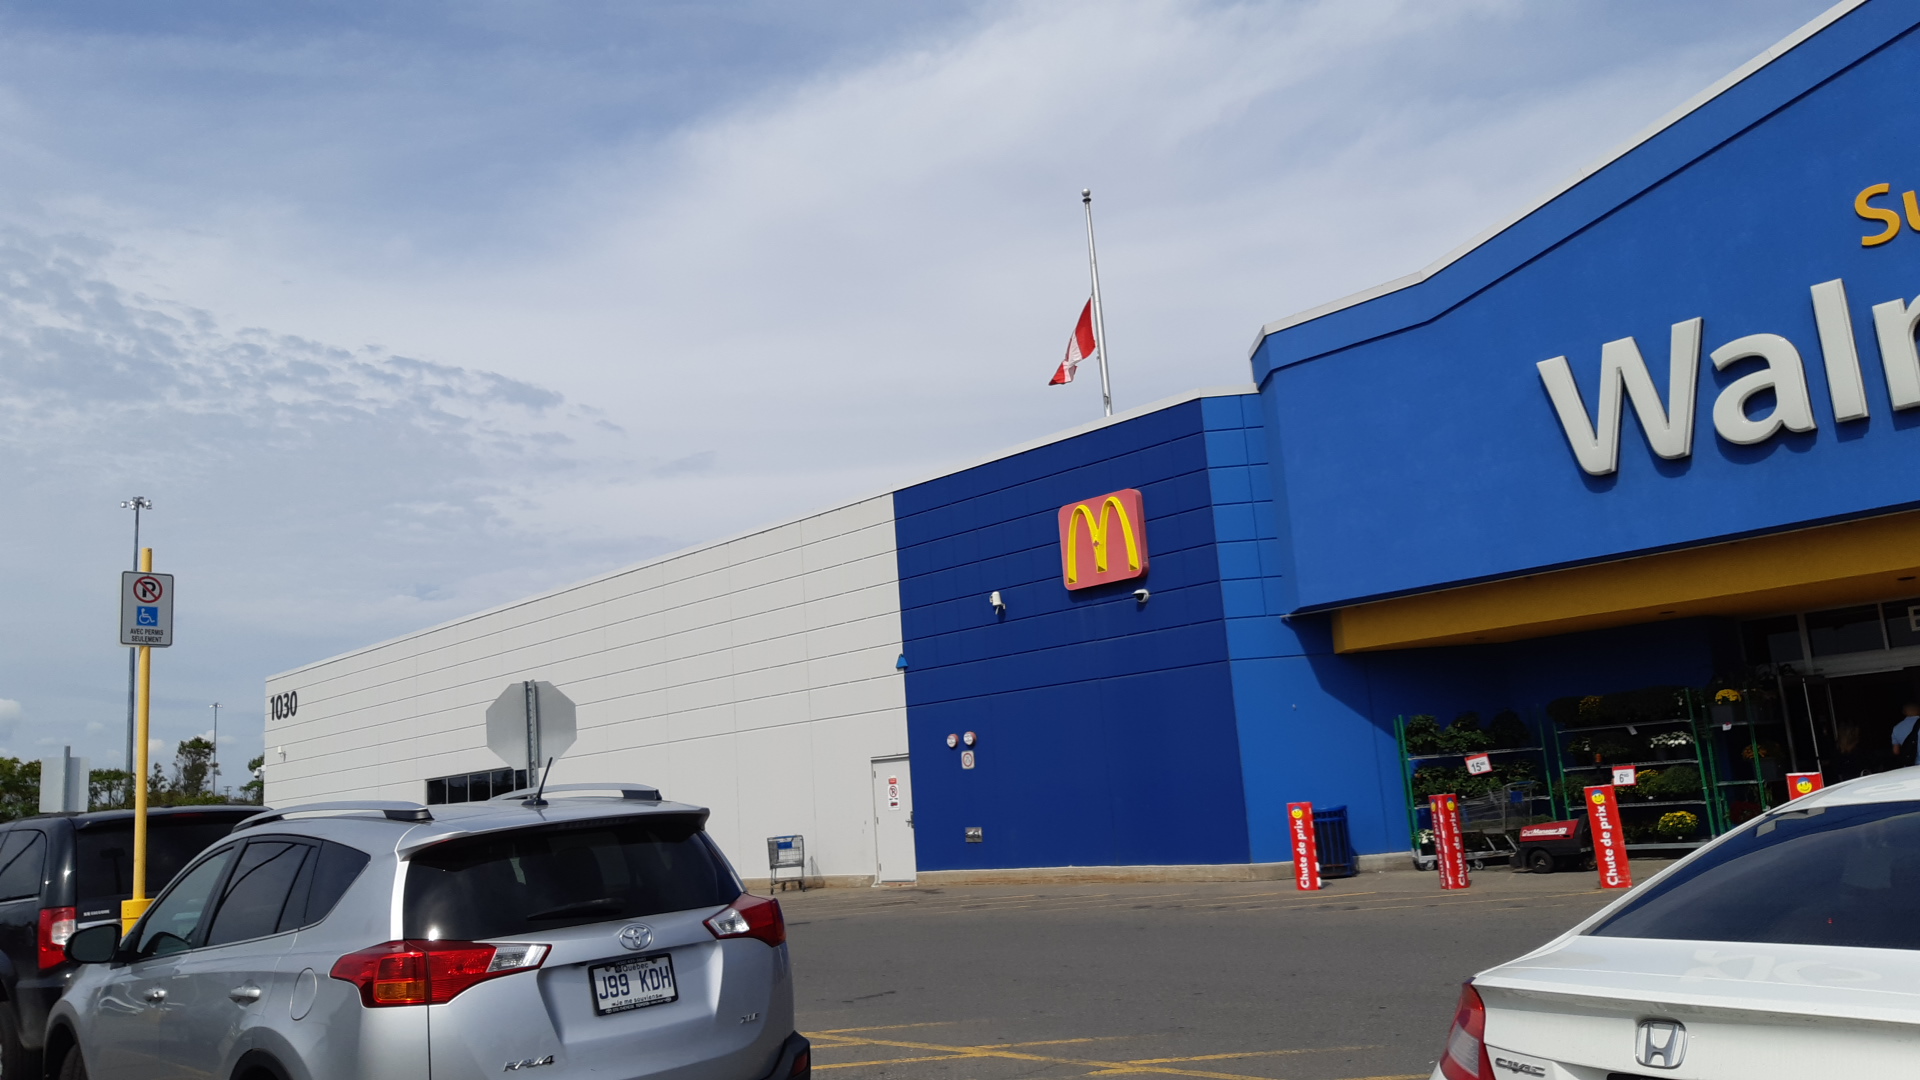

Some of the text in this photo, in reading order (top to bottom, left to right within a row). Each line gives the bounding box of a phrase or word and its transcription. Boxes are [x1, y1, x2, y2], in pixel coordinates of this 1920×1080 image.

[270, 690, 298, 721] 1030
[1294, 819, 1310, 889] Chute de prix
[1450, 812, 1466, 886] Chute de prix
[1595, 805, 1619, 886] Chute de prix
[599, 965, 672, 1000] J99 KDH
[622, 963, 649, 973] Québec
[634, 994, 659, 1002] souviens
[503, 1054, 555, 1072] RAV4
